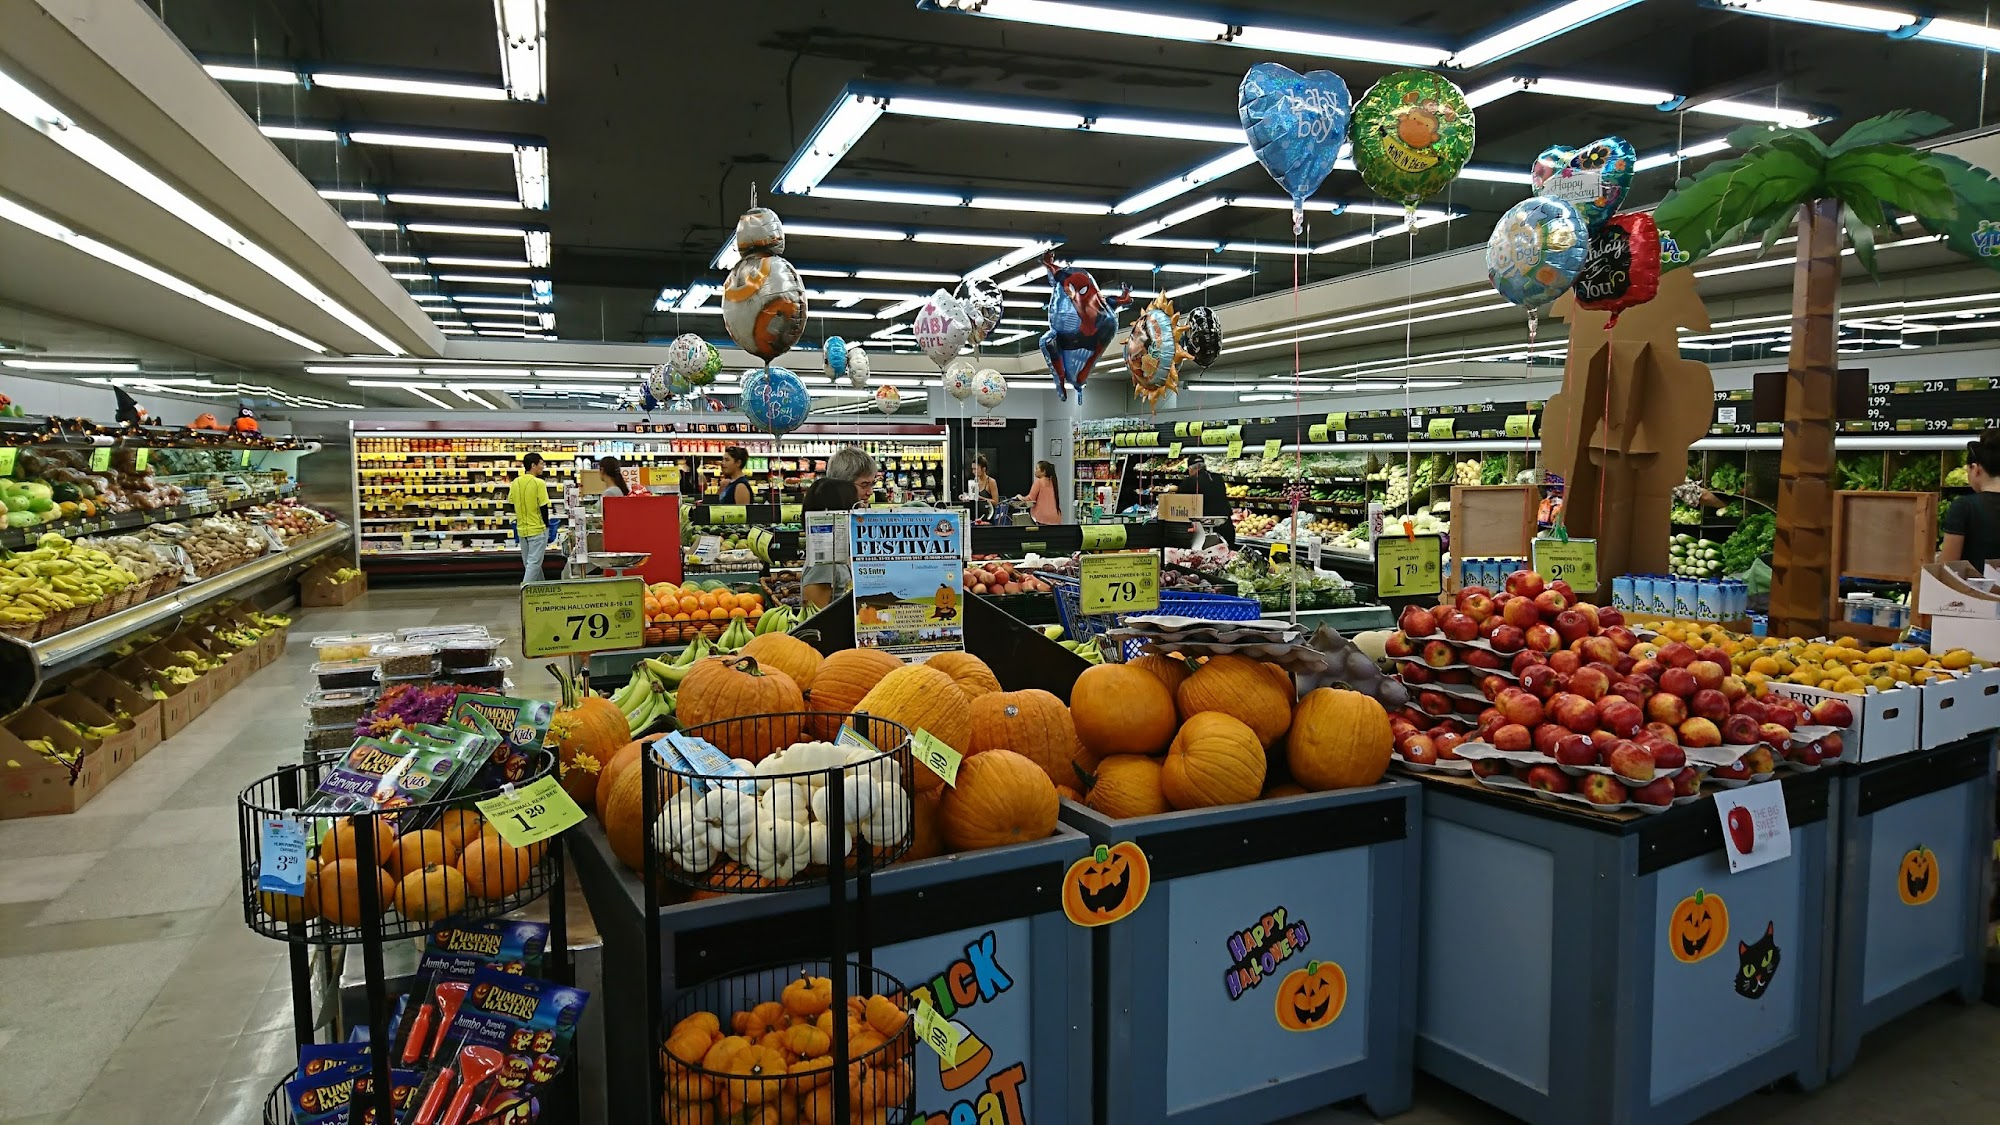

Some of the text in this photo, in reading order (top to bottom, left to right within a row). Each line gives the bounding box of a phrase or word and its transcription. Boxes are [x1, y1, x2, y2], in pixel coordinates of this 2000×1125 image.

[1286, 89, 1337, 117] baby
[1296, 112, 1334, 143] boy
[1581, 280, 1613, 298] You
[915, 316, 953, 335] BABY
[856, 524, 931, 539] PUMPKIN
[856, 540, 955, 555] FESTIVAL
[858, 567, 886, 576] $3 Entry
[1099, 581, 1137, 603] .79
[567, 602, 609, 610] HALLOWEEN
[553, 613, 610, 642] .79
[474, 703, 518, 721] PUMPKIN
[513, 728, 534, 745] Kids
[326, 771, 375, 793] Carving Kit
[400, 773, 428, 789] Kids
[491, 808, 515, 818] PUMPKIN
[514, 801, 533, 811] SMALL
[1753, 805, 1779, 818] THE BIG
[1756, 816, 1779, 830] SWEET
[451, 928, 502, 946] PUMPKIN
[1228, 907, 1286, 962] HAPPY
[449, 939, 500, 955] MASTERS
[422, 957, 449, 969] Jumbo
[1226, 922, 1309, 998] HALLOWEEN
[489, 985, 539, 1011] PUMPKIN
[482, 999, 534, 1020] MASTERS
[454, 1014, 481, 1030] Jumbo
[485, 1018, 507, 1031] Pumpkin
[479, 1026, 499, 1038] Carving
